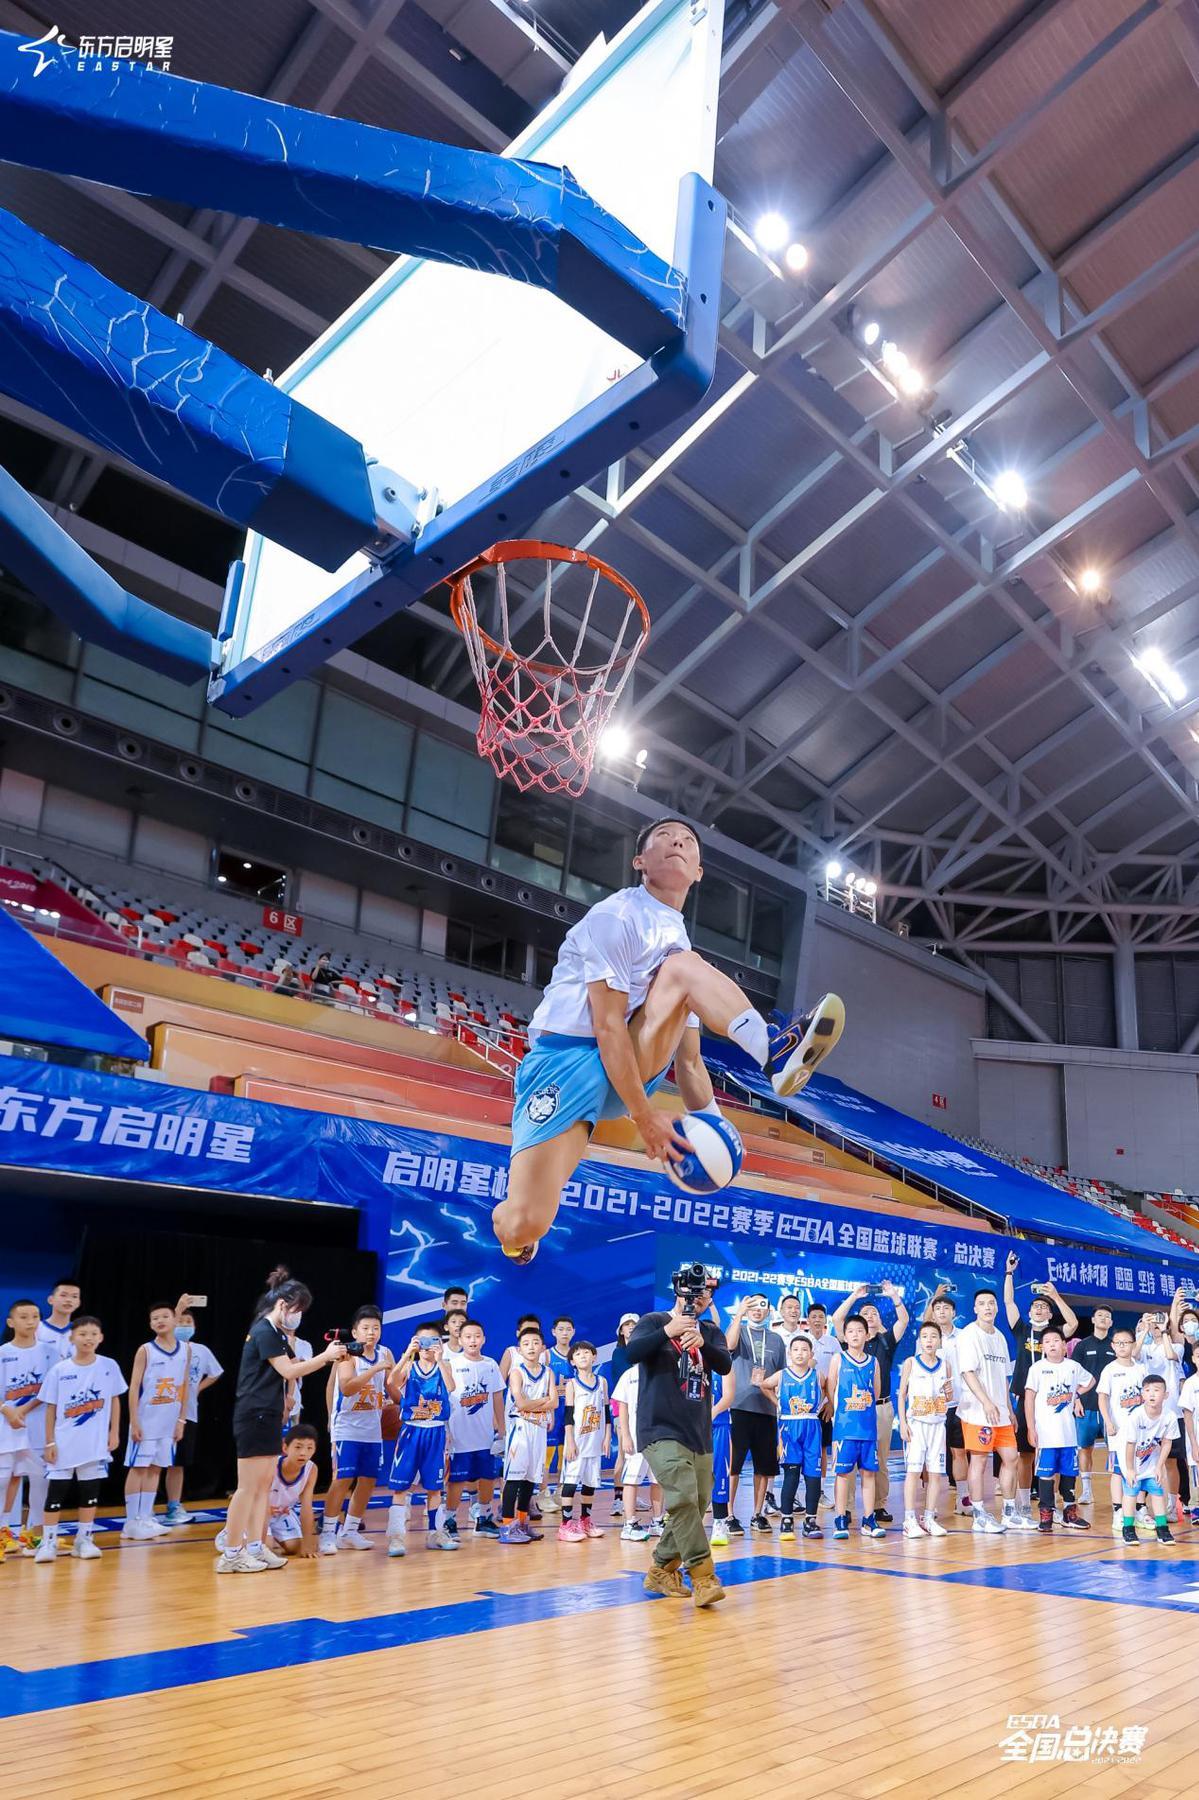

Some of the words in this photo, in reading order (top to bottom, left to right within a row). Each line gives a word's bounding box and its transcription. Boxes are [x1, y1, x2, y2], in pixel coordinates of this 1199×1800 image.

[0, 1086, 256, 1163] 东方启明星
